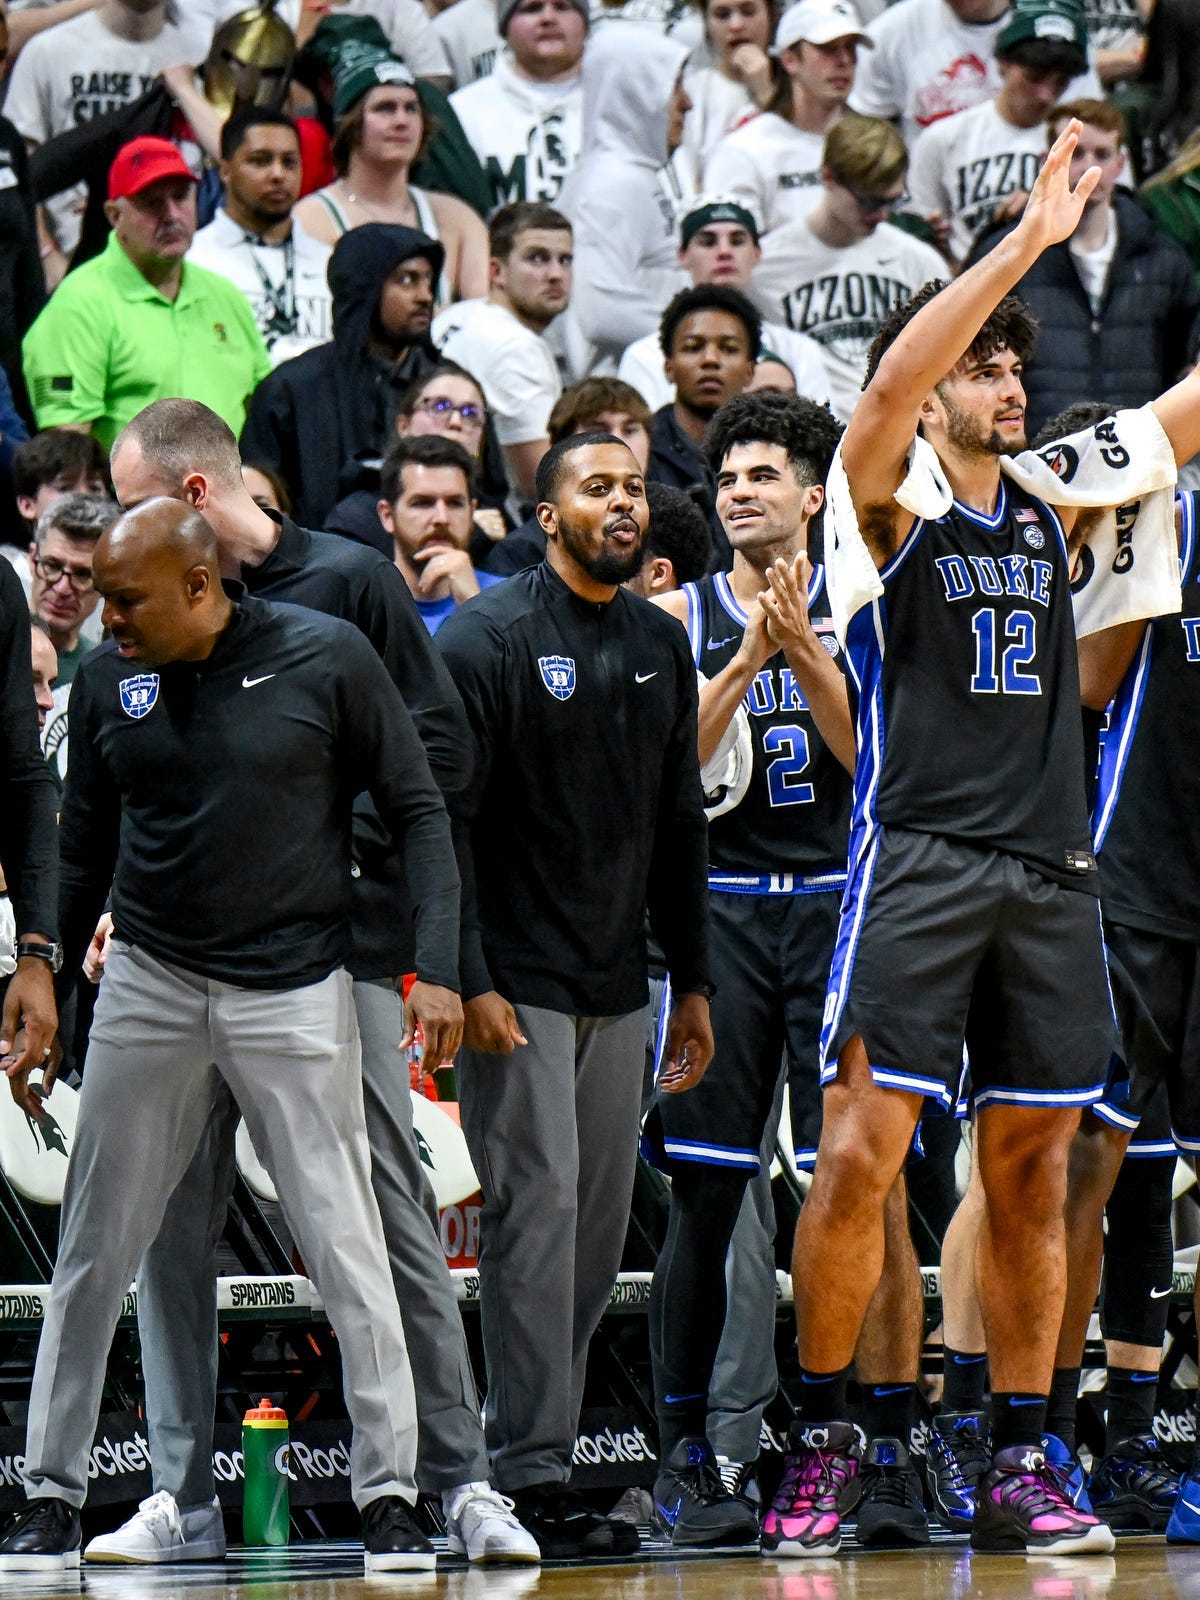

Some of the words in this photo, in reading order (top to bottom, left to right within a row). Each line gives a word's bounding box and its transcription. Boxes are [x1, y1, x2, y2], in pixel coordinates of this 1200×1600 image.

[71, 72, 132, 98] RAISE
[1095, 412, 1131, 470] GA
[935, 554, 1053, 608] DUKE
[970, 607, 1043, 695] 12
[748, 668, 810, 717] UK
[763, 724, 815, 807] 2
[230, 1281, 297, 1307] SPARTANS
